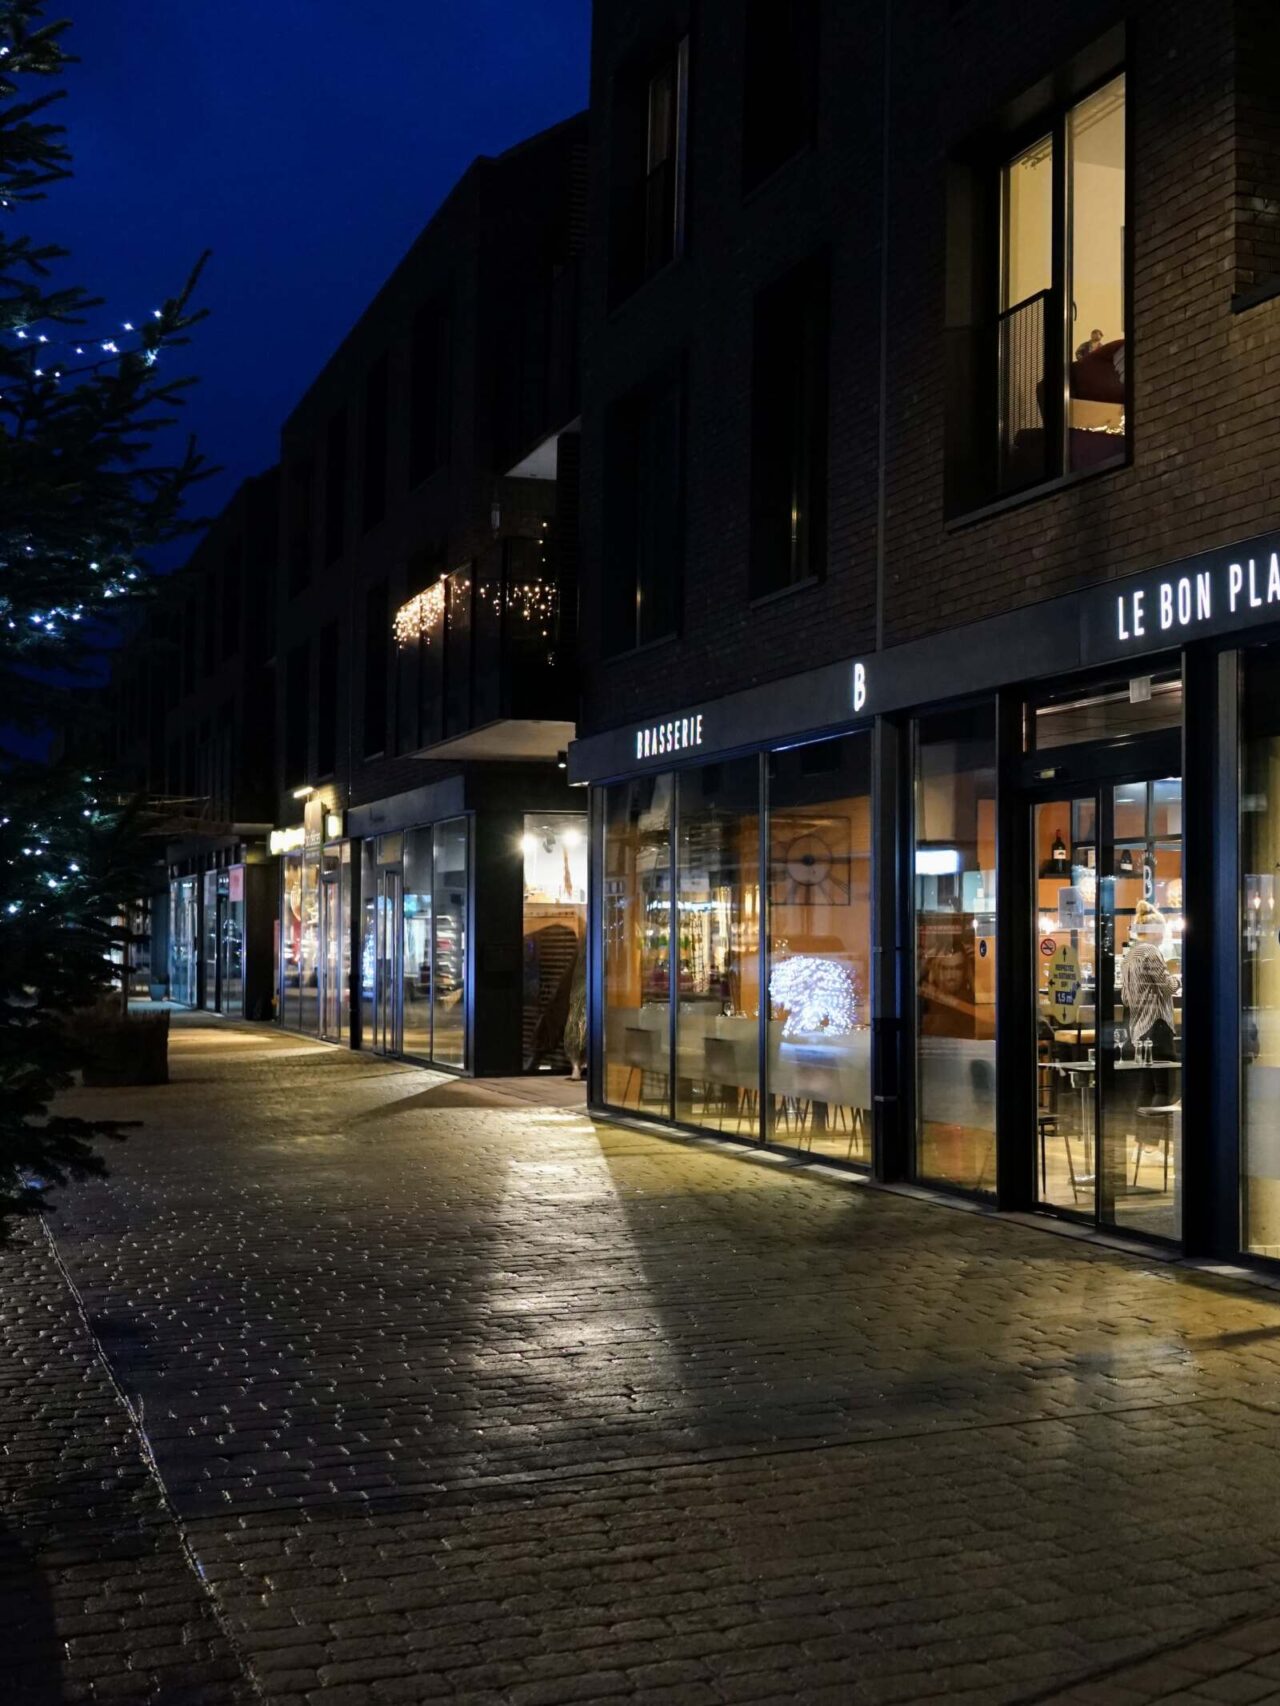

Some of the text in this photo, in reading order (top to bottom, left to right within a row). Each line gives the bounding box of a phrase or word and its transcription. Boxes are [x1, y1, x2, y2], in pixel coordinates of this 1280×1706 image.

[1117, 590, 1146, 641] LE
[1159, 571, 1212, 631] BON
[852, 662, 867, 712] B
[636, 714, 703, 760] BRASSERIE
[1143, 865, 1153, 898] B
